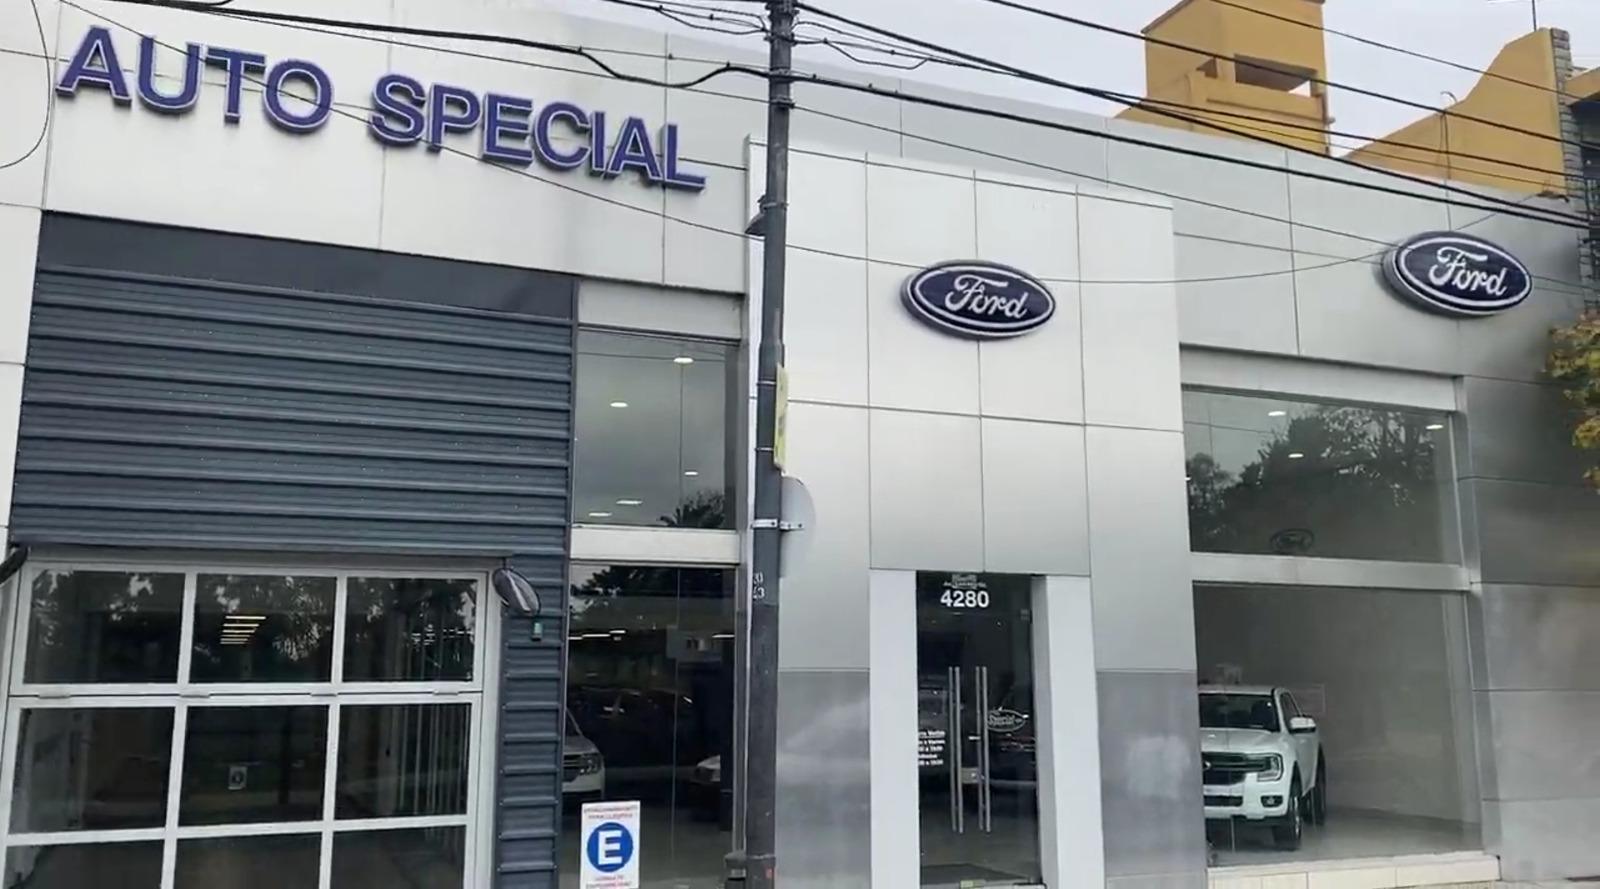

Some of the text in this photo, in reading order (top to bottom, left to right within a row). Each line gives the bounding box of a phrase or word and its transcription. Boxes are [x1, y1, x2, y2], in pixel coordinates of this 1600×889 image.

[55, 25, 706, 191] AUTO SPECIAL
[1428, 246, 1508, 296] Ford
[944, 274, 1029, 318] Ford
[940, 589, 990, 608] 4280
[597, 829, 623, 866] E
